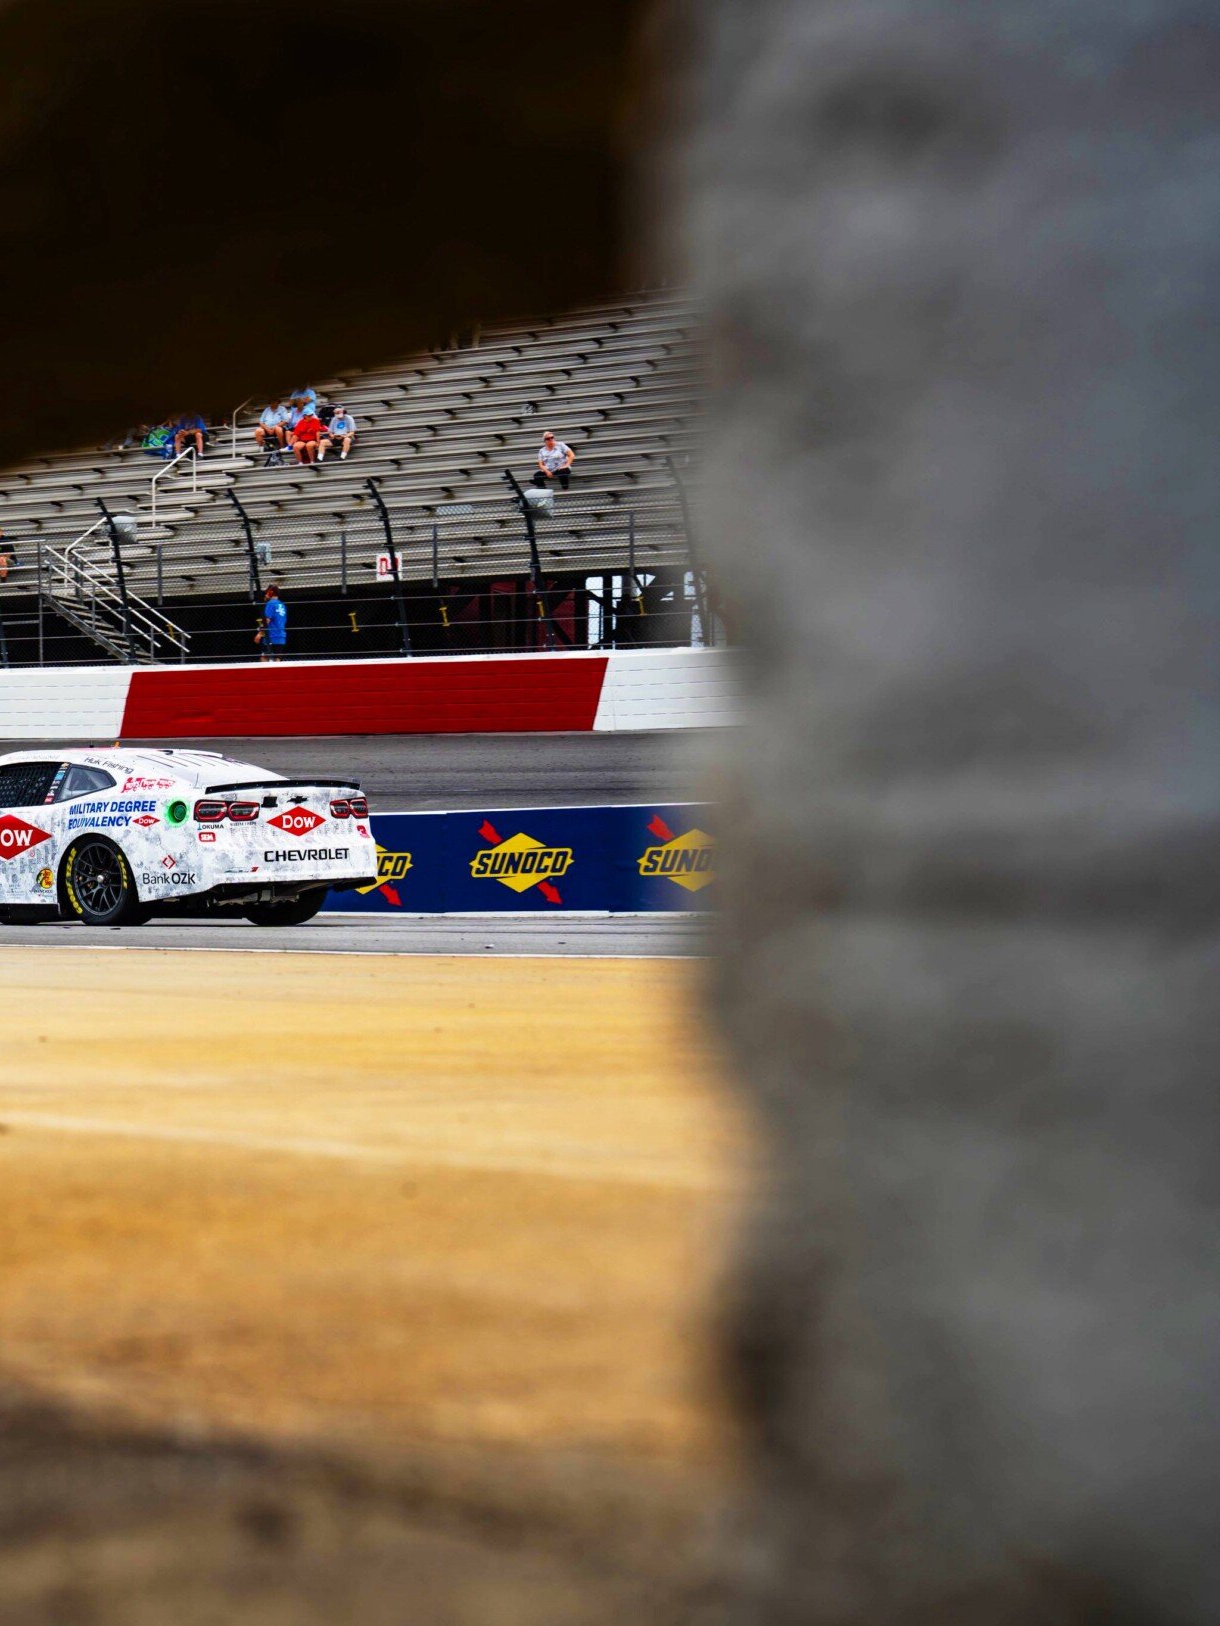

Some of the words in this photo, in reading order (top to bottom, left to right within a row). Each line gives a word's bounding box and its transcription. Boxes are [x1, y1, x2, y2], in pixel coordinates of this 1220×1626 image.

[70, 802, 109, 815] MILITARY
[110, 801, 157, 812] DEGREE
[69, 816, 132, 830] EQUIVALENCY
[264, 848, 350, 862] CHEVROLET
[476, 851, 566, 874] SUNOCO
